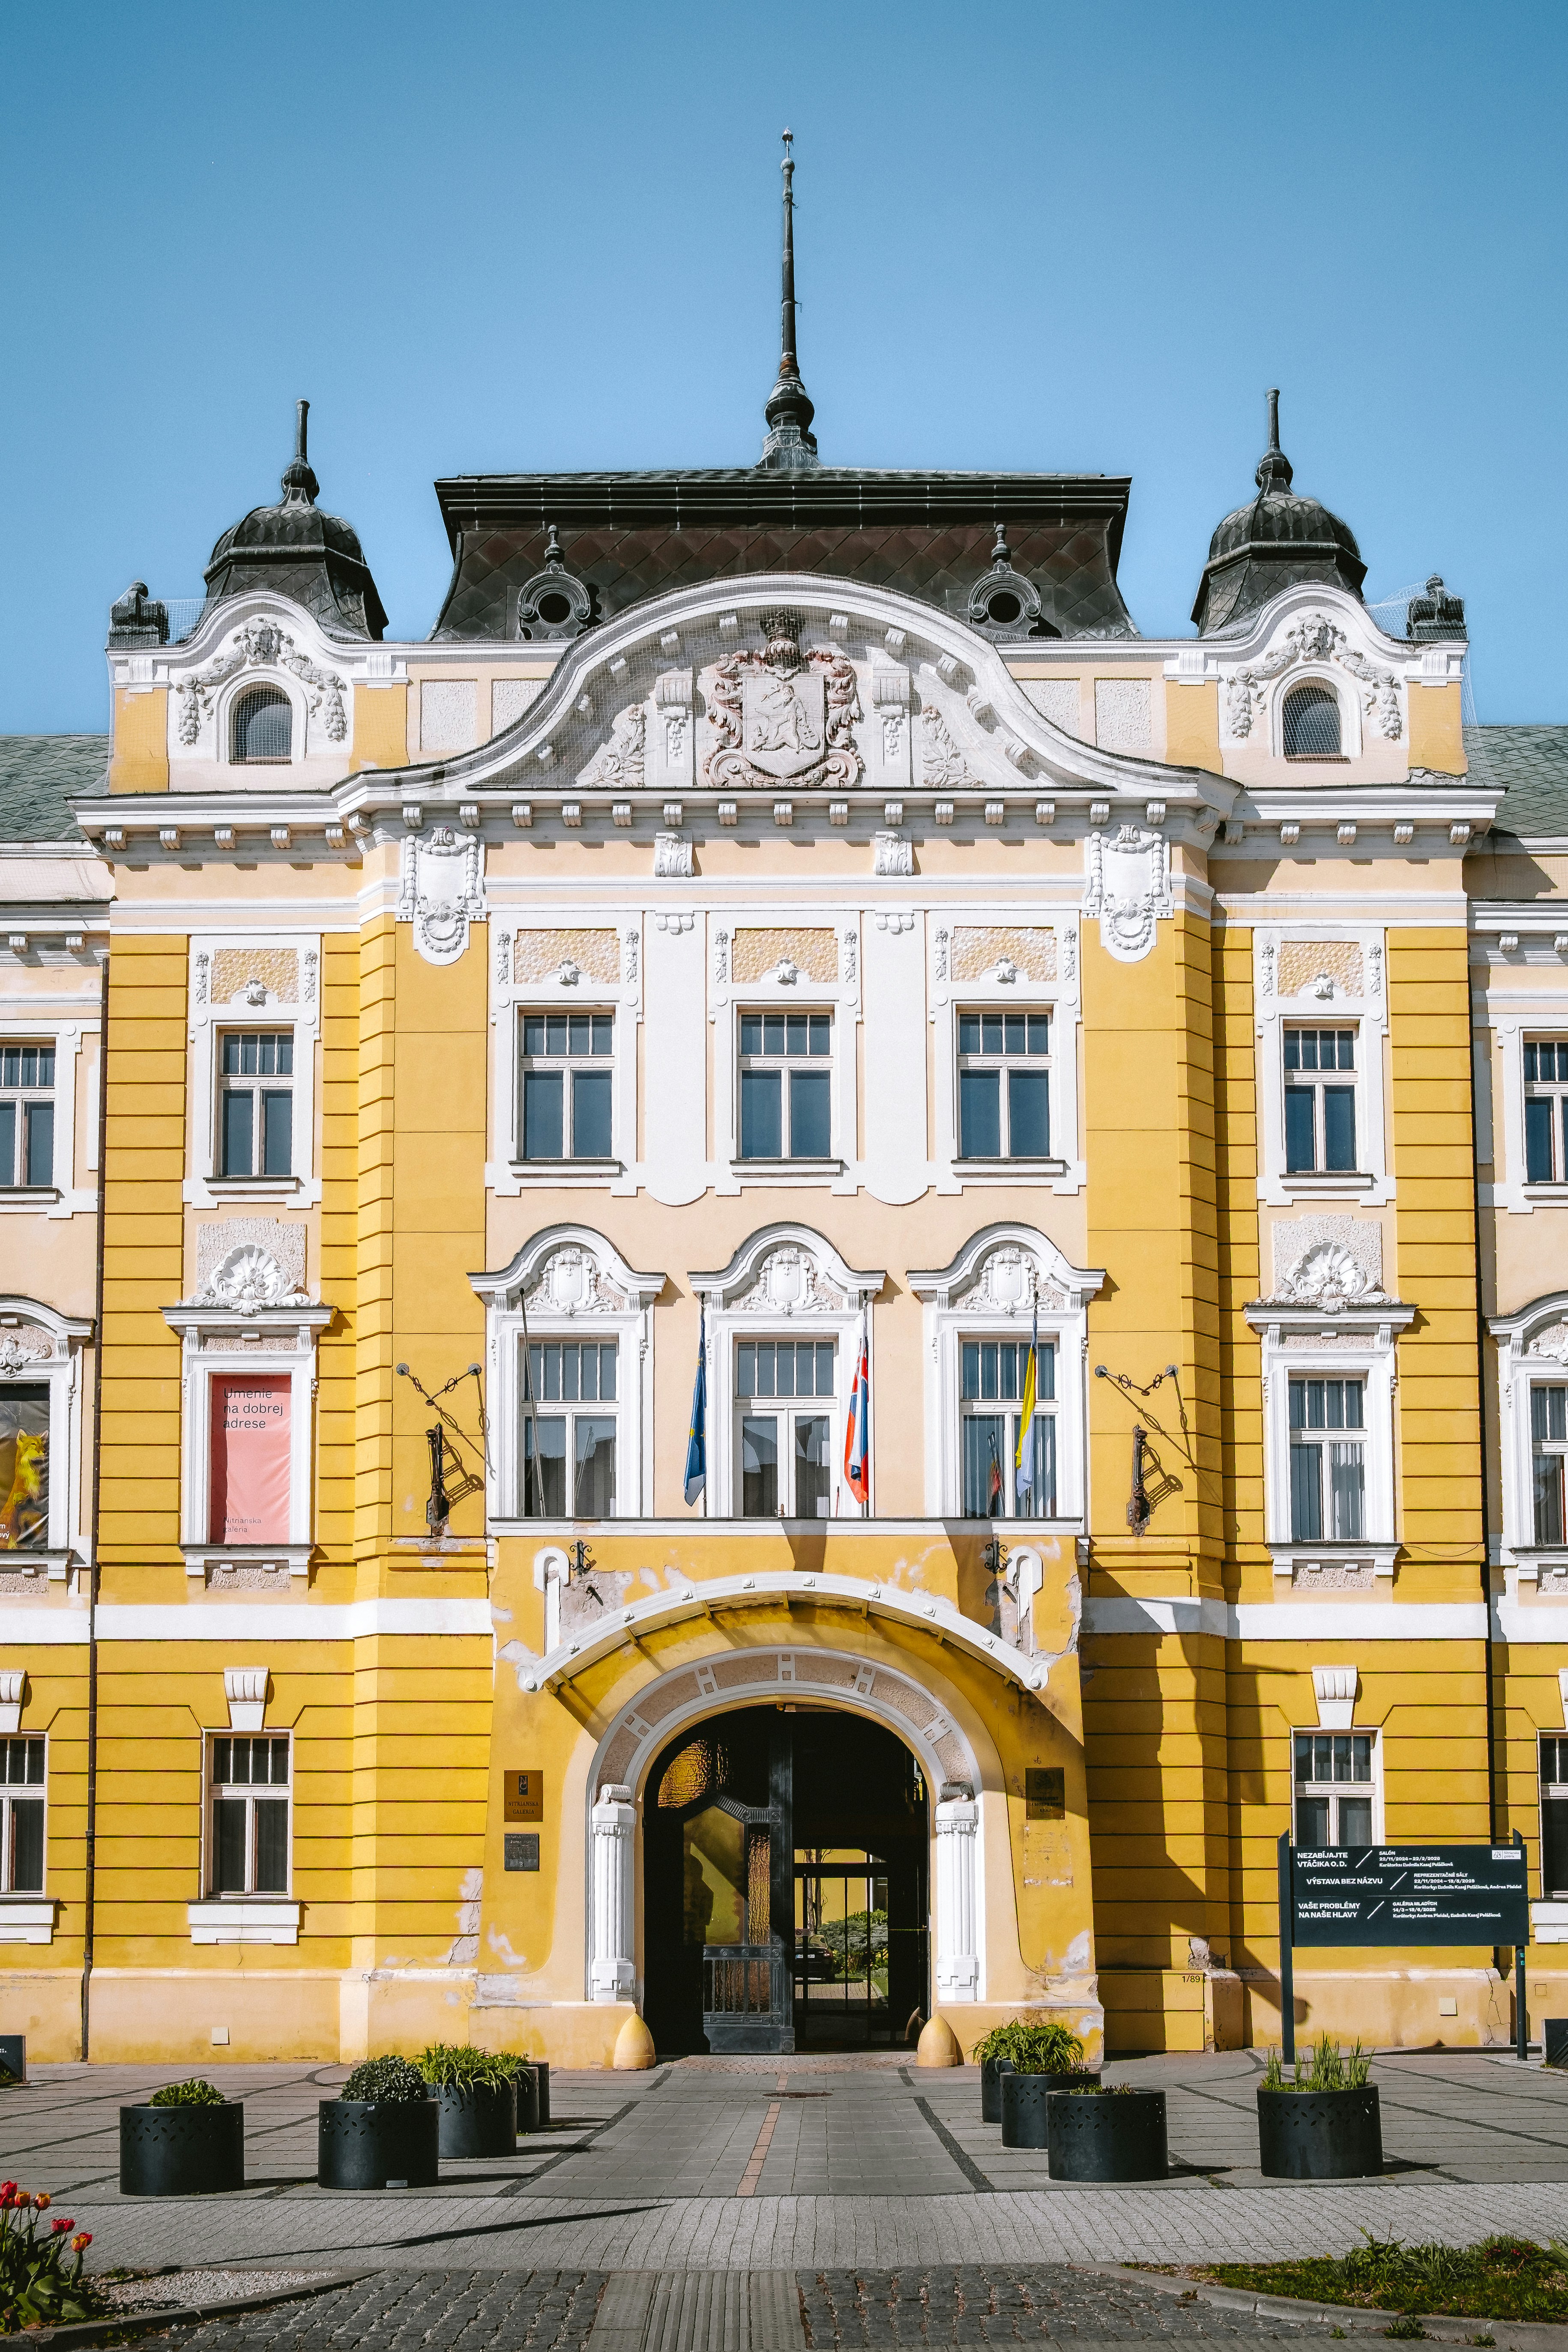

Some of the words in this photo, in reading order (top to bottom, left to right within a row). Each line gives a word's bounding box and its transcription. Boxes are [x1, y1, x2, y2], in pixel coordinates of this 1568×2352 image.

[224, 1388, 272, 1398] Umenie
[224, 1405, 239, 1413] na
[243, 1403, 283, 1416] dobrej
[223, 1418, 266, 1428] adrese
